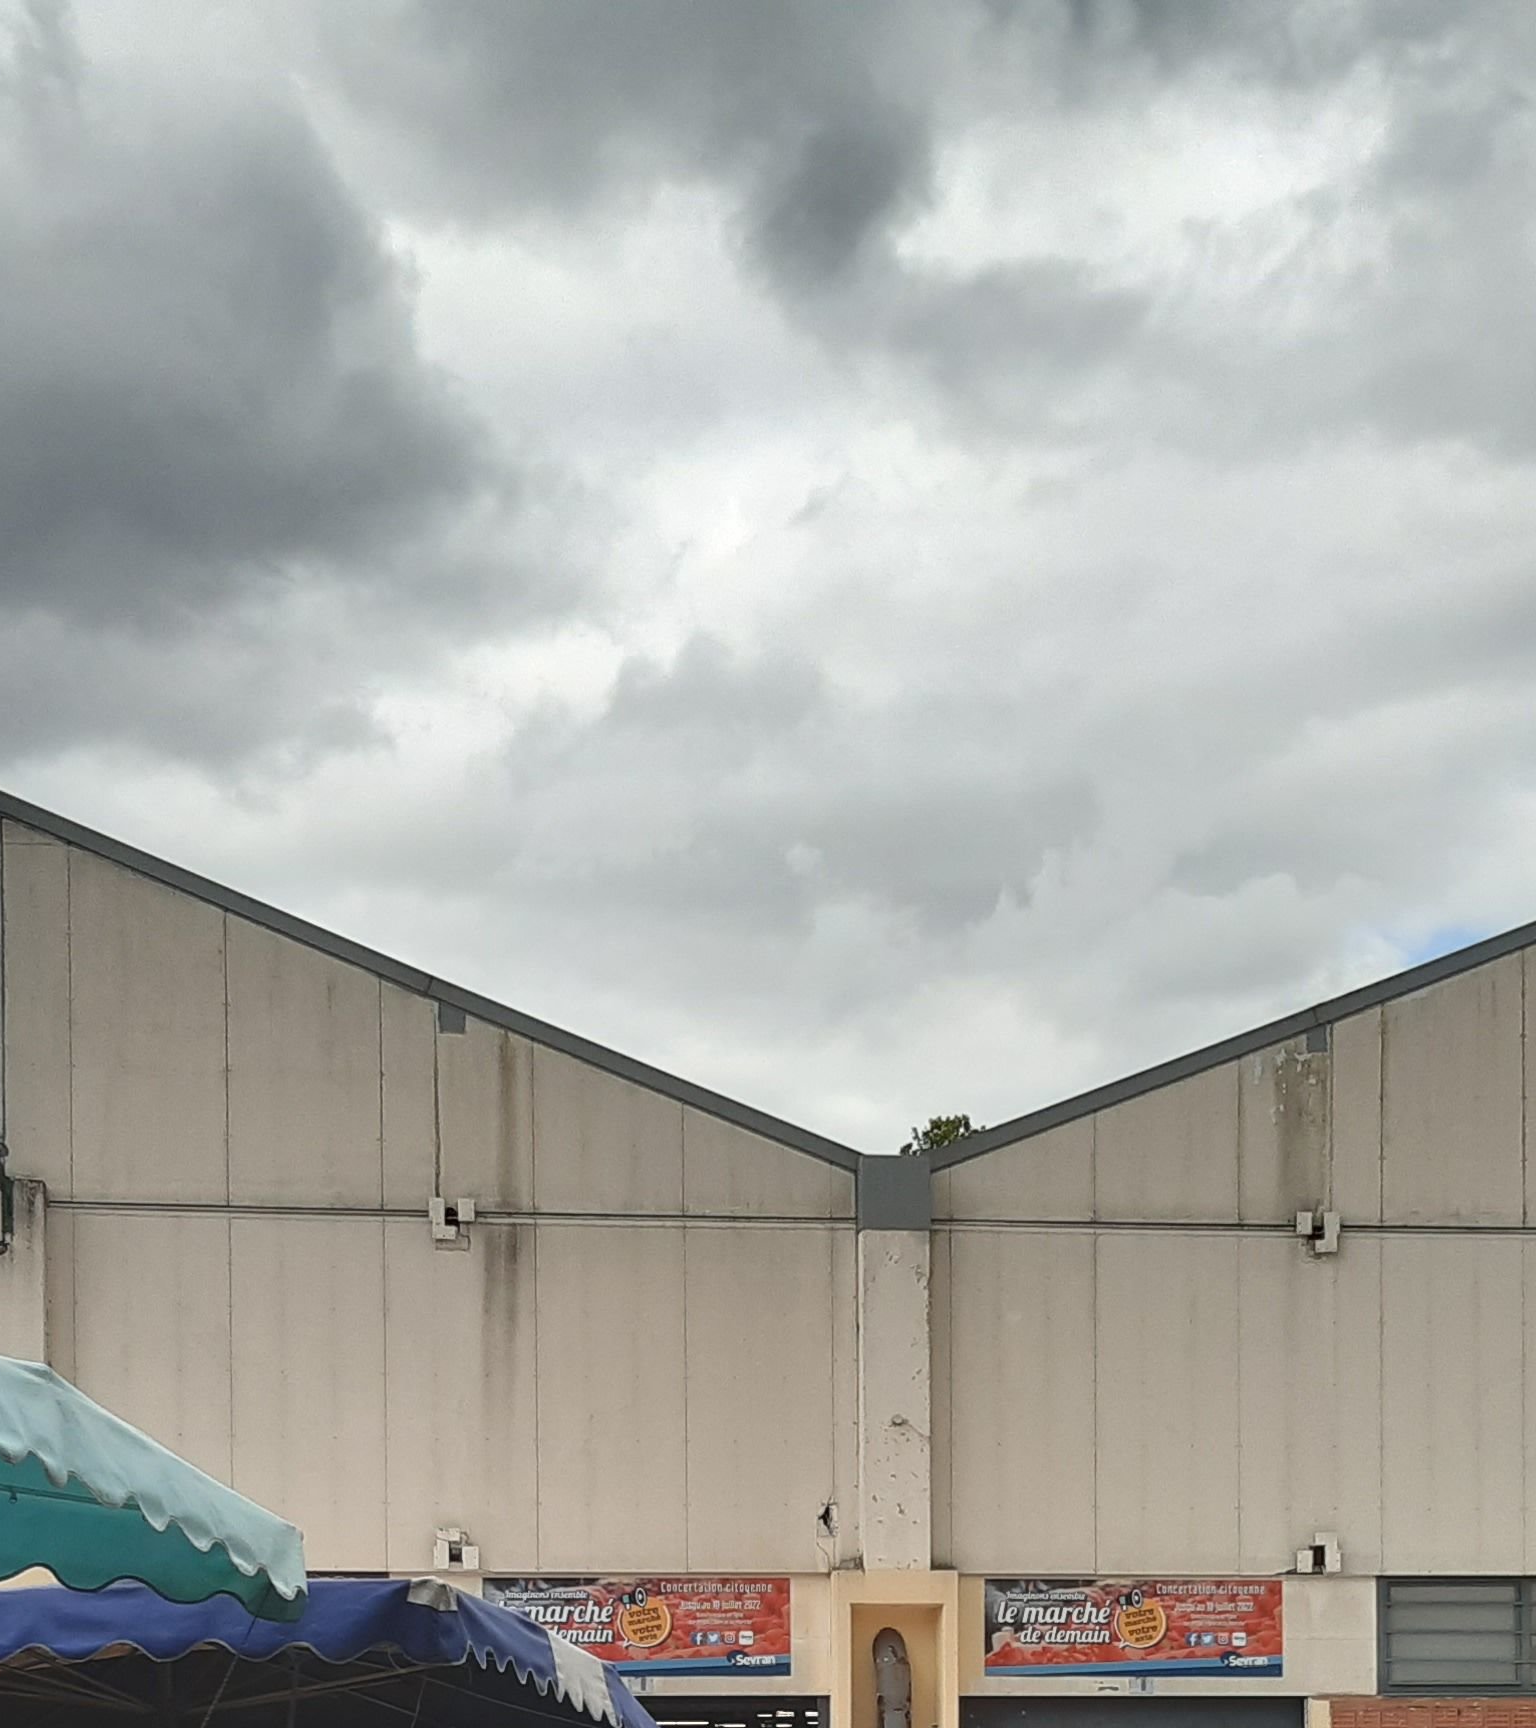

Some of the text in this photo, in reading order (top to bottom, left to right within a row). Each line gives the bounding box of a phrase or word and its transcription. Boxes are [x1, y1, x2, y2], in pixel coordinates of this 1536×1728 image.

[660, 1581, 773, 1594] Concertation citoyenne
[1156, 1583, 1265, 1596] Concertation citoyenne
[504, 1590, 588, 1601] Imaginons ensemble
[528, 1598, 614, 1623] marché
[628, 1607, 659, 1619] votre
[997, 1600, 1111, 1624] le marché
[1125, 1608, 1154, 1620] votre
[627, 1615, 662, 1627] marché
[631, 1623, 662, 1636] votre
[1020, 1626, 1110, 1643] de demain
[1128, 1624, 1158, 1637] votre
[735, 1655, 776, 1666] Sevran
[1229, 1656, 1269, 1667] Sevran
